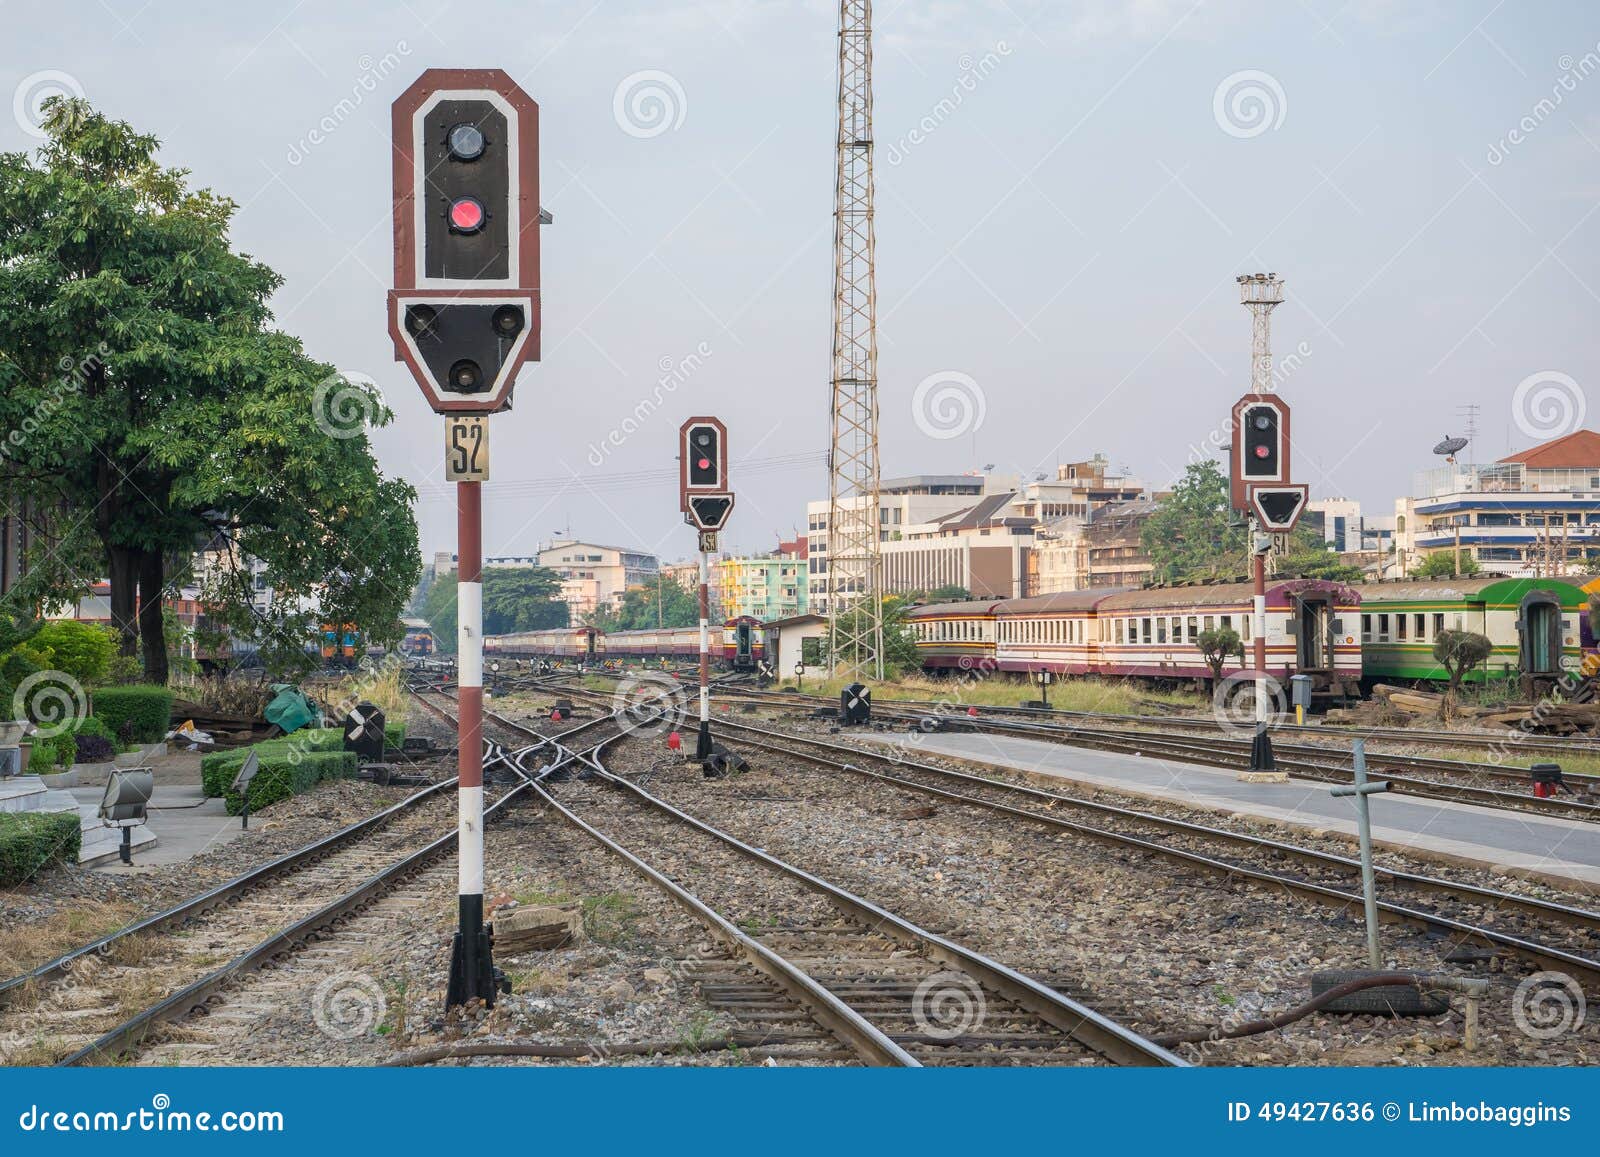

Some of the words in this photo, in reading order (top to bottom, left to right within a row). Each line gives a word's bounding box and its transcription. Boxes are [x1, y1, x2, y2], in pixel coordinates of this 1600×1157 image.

[453, 425, 483, 473] S2
[705, 534, 716, 551] S3
[1274, 535, 1286, 556] S4
